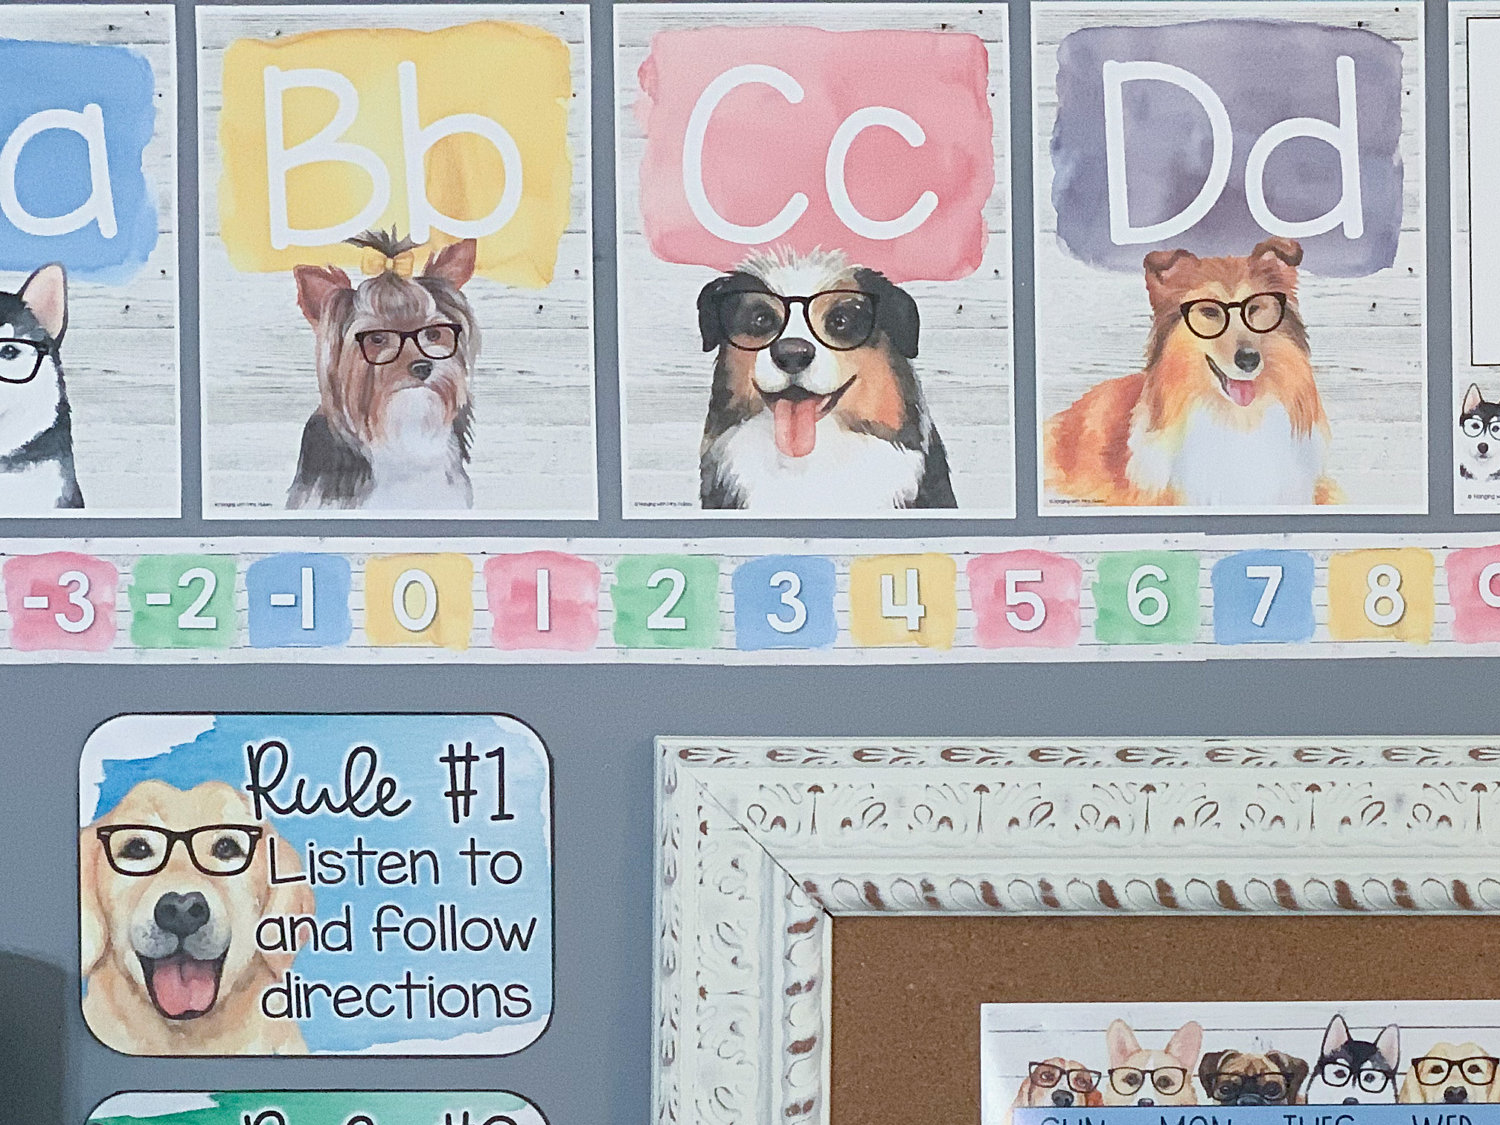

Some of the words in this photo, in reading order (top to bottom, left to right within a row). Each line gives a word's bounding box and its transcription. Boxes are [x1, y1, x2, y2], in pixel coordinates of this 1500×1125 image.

[263, 60, 523, 250] Bb
[682, 64, 938, 244] Cc
[1103, 56, 1364, 245] Dd
[23, 570, 96, 633] -3
[145, 567, 217, 629] -2
[270, 567, 315, 630] -1
[392, 568, 438, 632] 0
[536, 568, 550, 631] 1
[646, 568, 687, 630] 2
[767, 570, 808, 632] 3
[880, 568, 925, 631] 4
[1005, 569, 1046, 631] 5
[1126, 565, 1169, 626] 6
[1245, 565, 1284, 627] 7
[1363, 564, 1406, 626] 8
[246, 740, 411, 821] Rule
[439, 741, 515, 823] #1
[269, 837, 439, 886] Listen
[459, 838, 522, 886] to
[255, 905, 351, 953] and
[372, 904, 537, 953] follow
[262, 970, 532, 1019] directions
